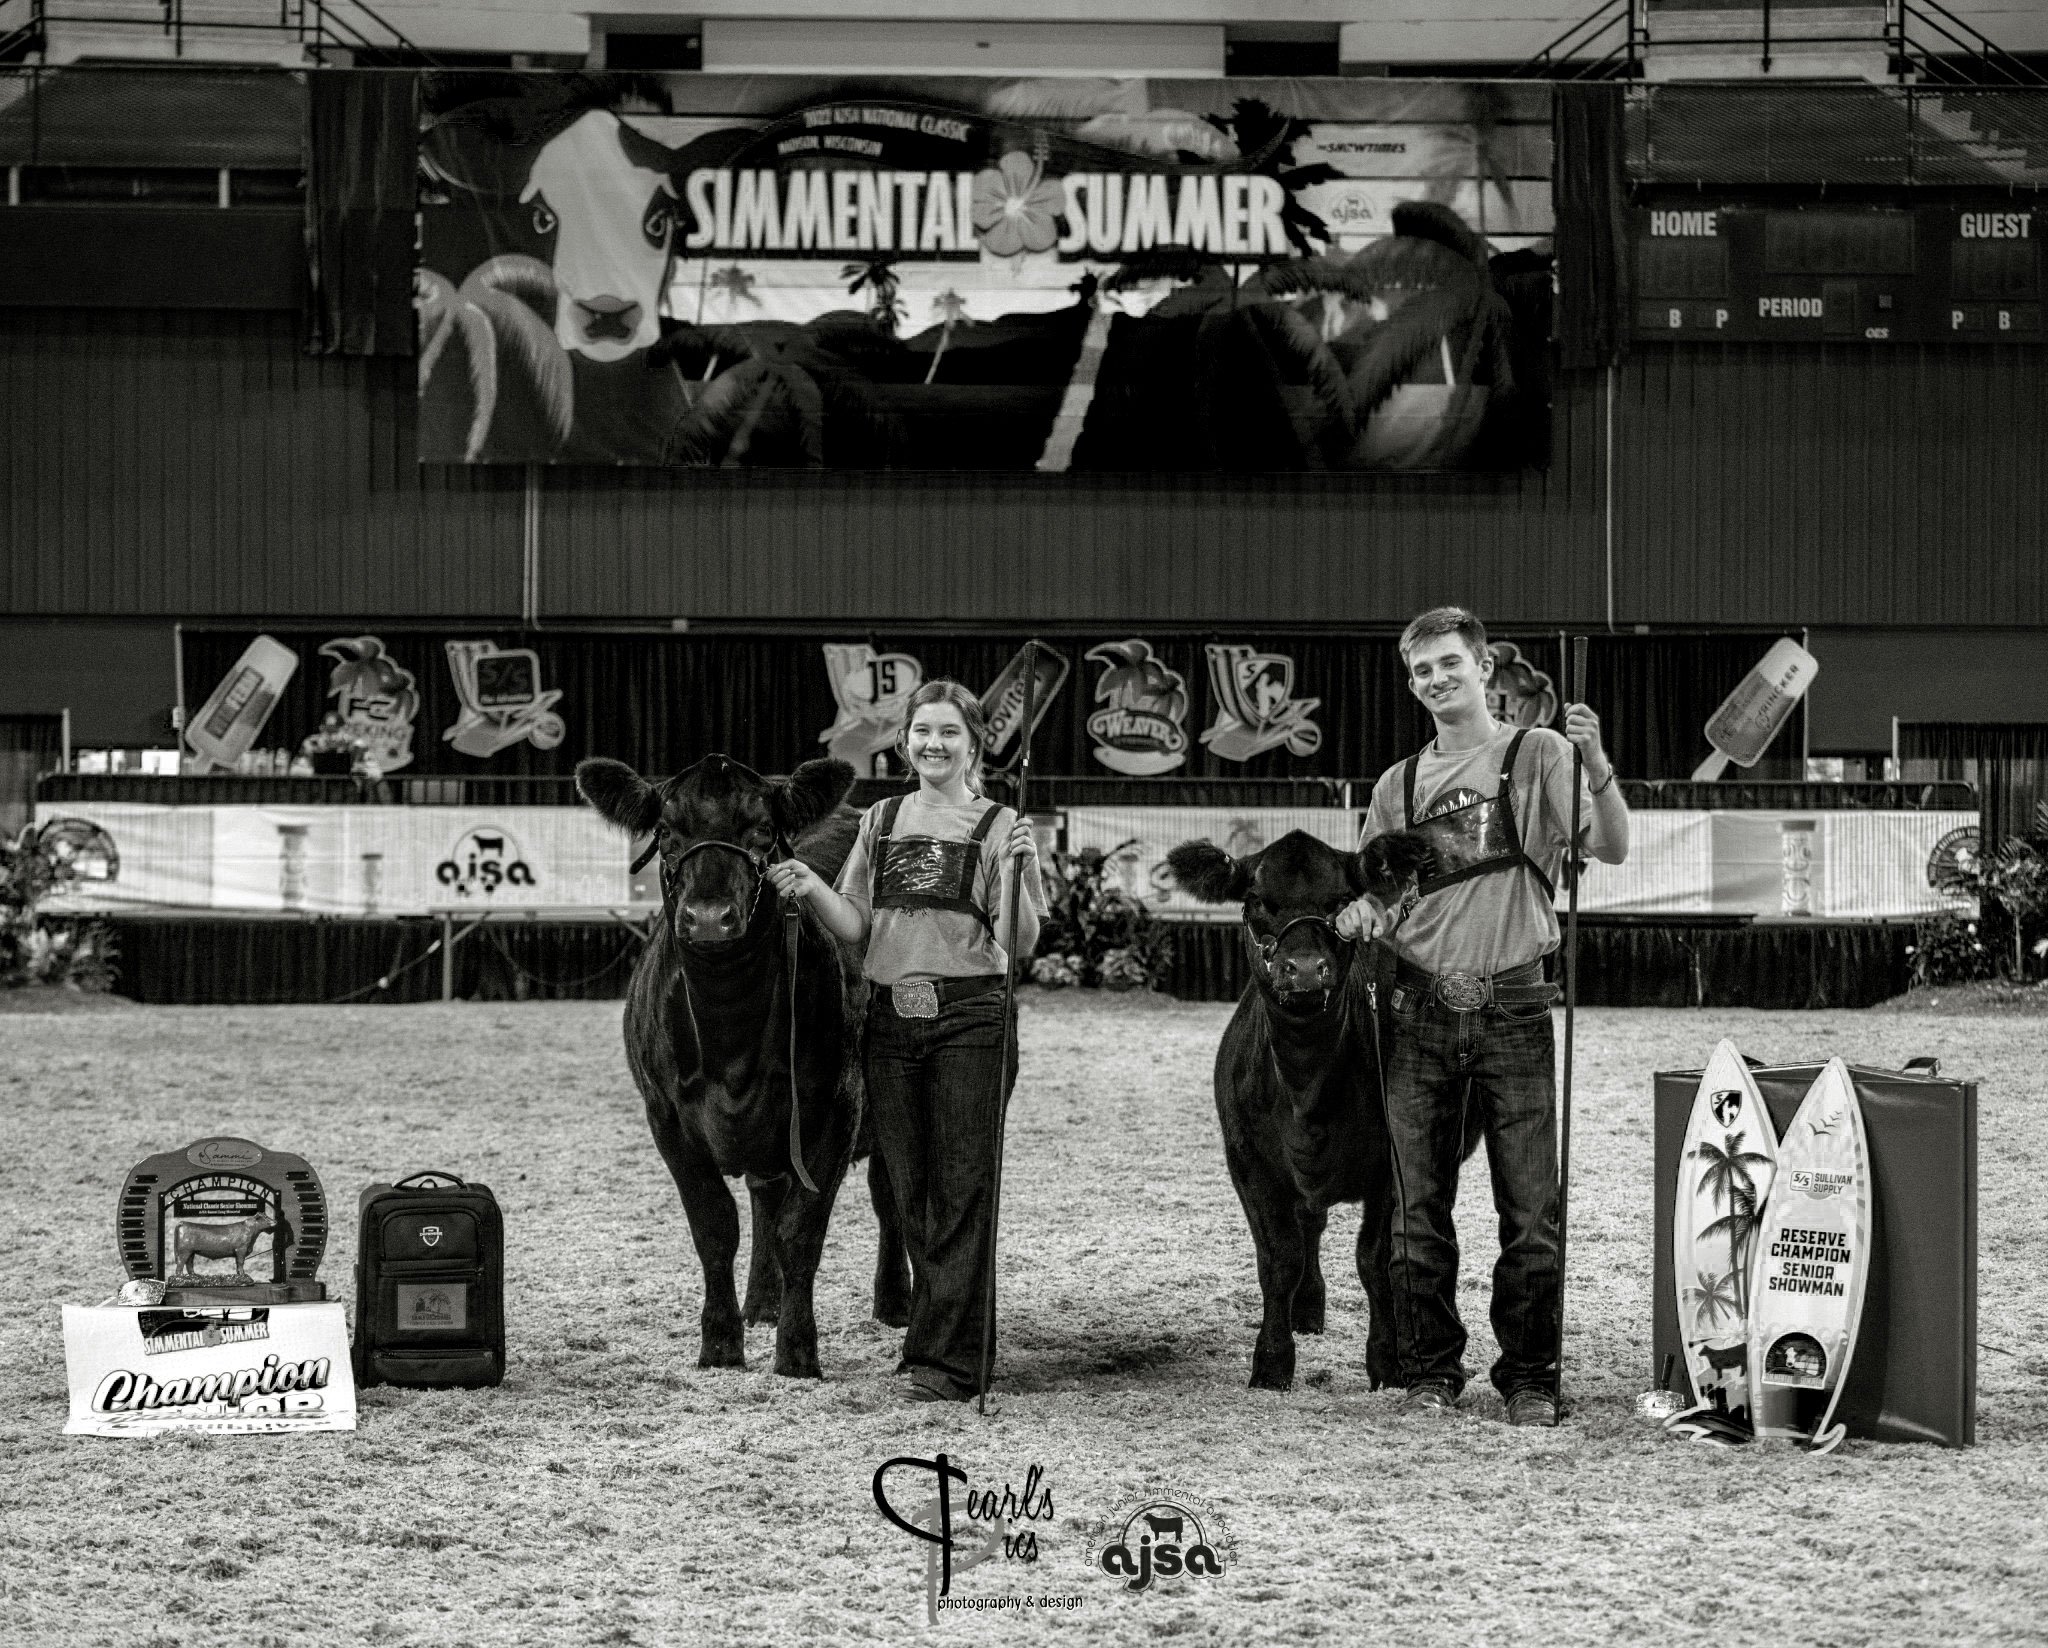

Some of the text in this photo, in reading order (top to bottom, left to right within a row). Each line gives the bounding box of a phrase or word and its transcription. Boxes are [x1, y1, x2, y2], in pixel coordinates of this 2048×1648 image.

[862, 109, 917, 131] NATIONAL
[920, 115, 970, 142] CLASSIC
[686, 169, 1286, 255] SIMMENTAL SUMMER
[1331, 205, 1373, 225] ajsa
[1650, 211, 1717, 236] HOME
[1960, 213, 2031, 238] GUEST
[1669, 309, 1729, 328] B P
[1758, 298, 1823, 318] PERIOD
[1952, 311, 2011, 329] P B
[1092, 709, 1183, 751] WEAVER
[170, 1175, 272, 1201] CHAMPION
[1793, 1173, 1811, 1187] S/S
[1813, 1183, 1844, 1195] SUPPLY
[1814, 1172, 1853, 1186] SULLIVAN
[183, 1202, 203, 1210] National
[1779, 1227, 1847, 1248] RESERVE
[1770, 1242, 1852, 1264] CHAMPION
[1782, 1261, 1835, 1280] SENIOR
[1768, 1276, 1845, 1297] SHOWMAN
[143, 1322, 269, 1355] SIMMENTAL SUMMER
[91, 1354, 331, 1414] Champion
